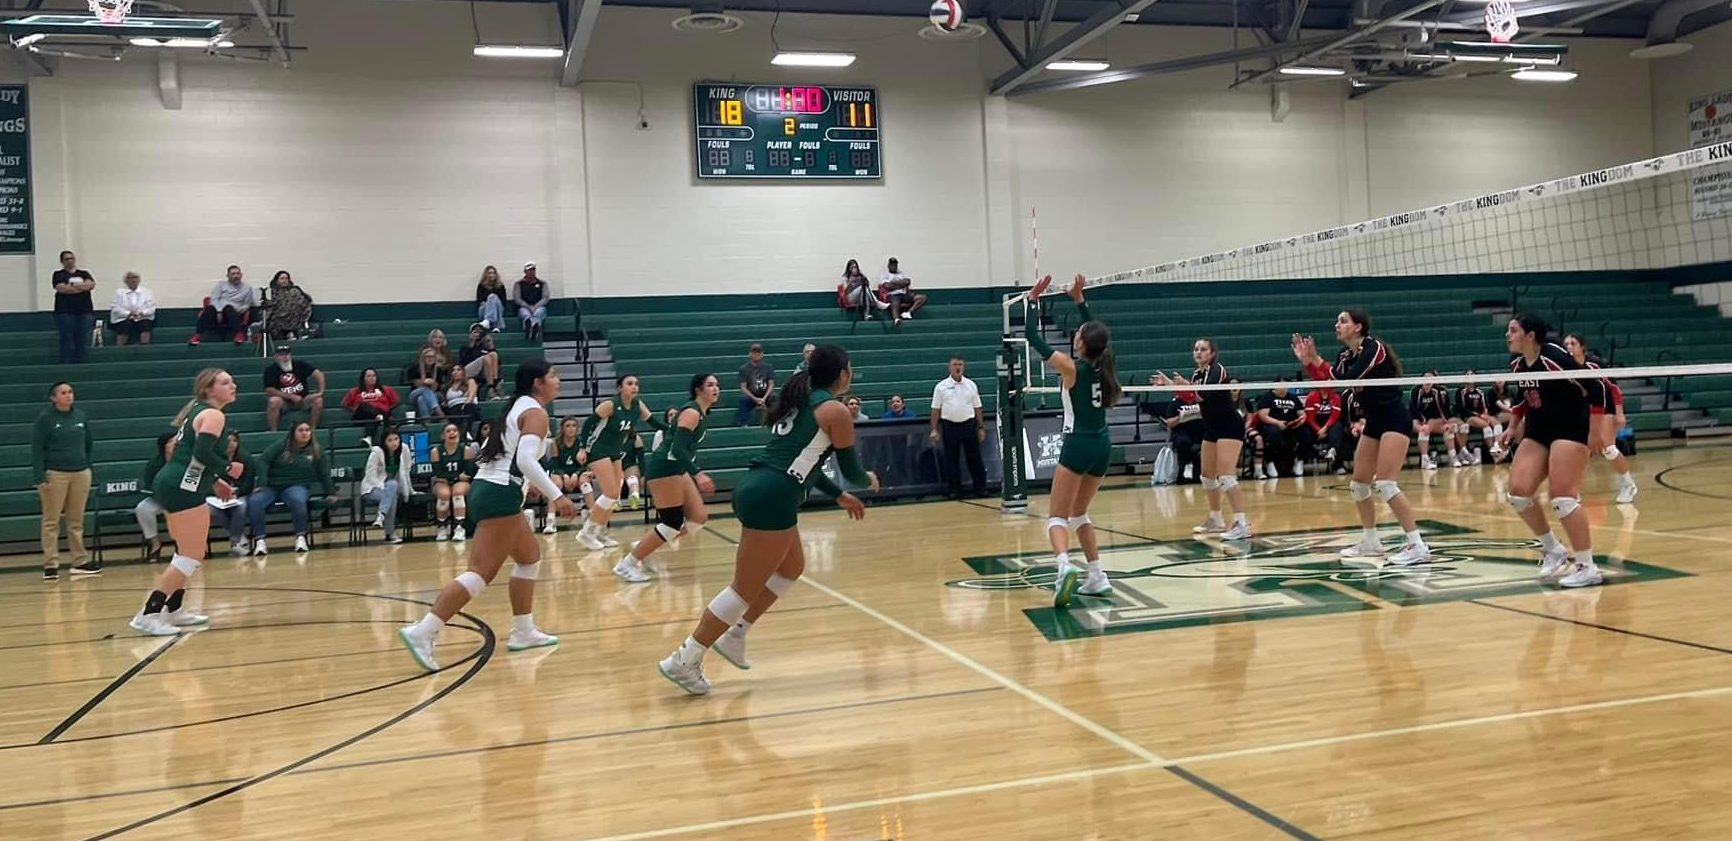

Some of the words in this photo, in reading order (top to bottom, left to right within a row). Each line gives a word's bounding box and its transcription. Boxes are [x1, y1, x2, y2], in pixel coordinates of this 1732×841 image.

[709, 87, 736, 98] KING
[833, 90, 871, 102] VISITOR
[719, 100, 742, 126] 18
[849, 103, 872, 127] 11
[784, 117, 796, 135] 2
[707, 140, 730, 149] FOULS
[766, 140, 792, 149] PLAYER
[799, 141, 821, 150] FOULS
[849, 142, 871, 150] FOULS
[1676, 150, 1704, 166] THE
[1555, 178, 1577, 193] THE
[1580, 165, 1635, 188] KINGDOM
[1456, 199, 1474, 214] THE
[1476, 189, 1521, 210] KINGDOM
[1372, 219, 1388, 230] THE
[1390, 210, 1427, 227] KINGDOM
[1519, 379, 1540, 388] EAST
[1091, 382, 1102, 408] 5
[446, 462, 459, 472] 11
[106, 481, 138, 494] KING
